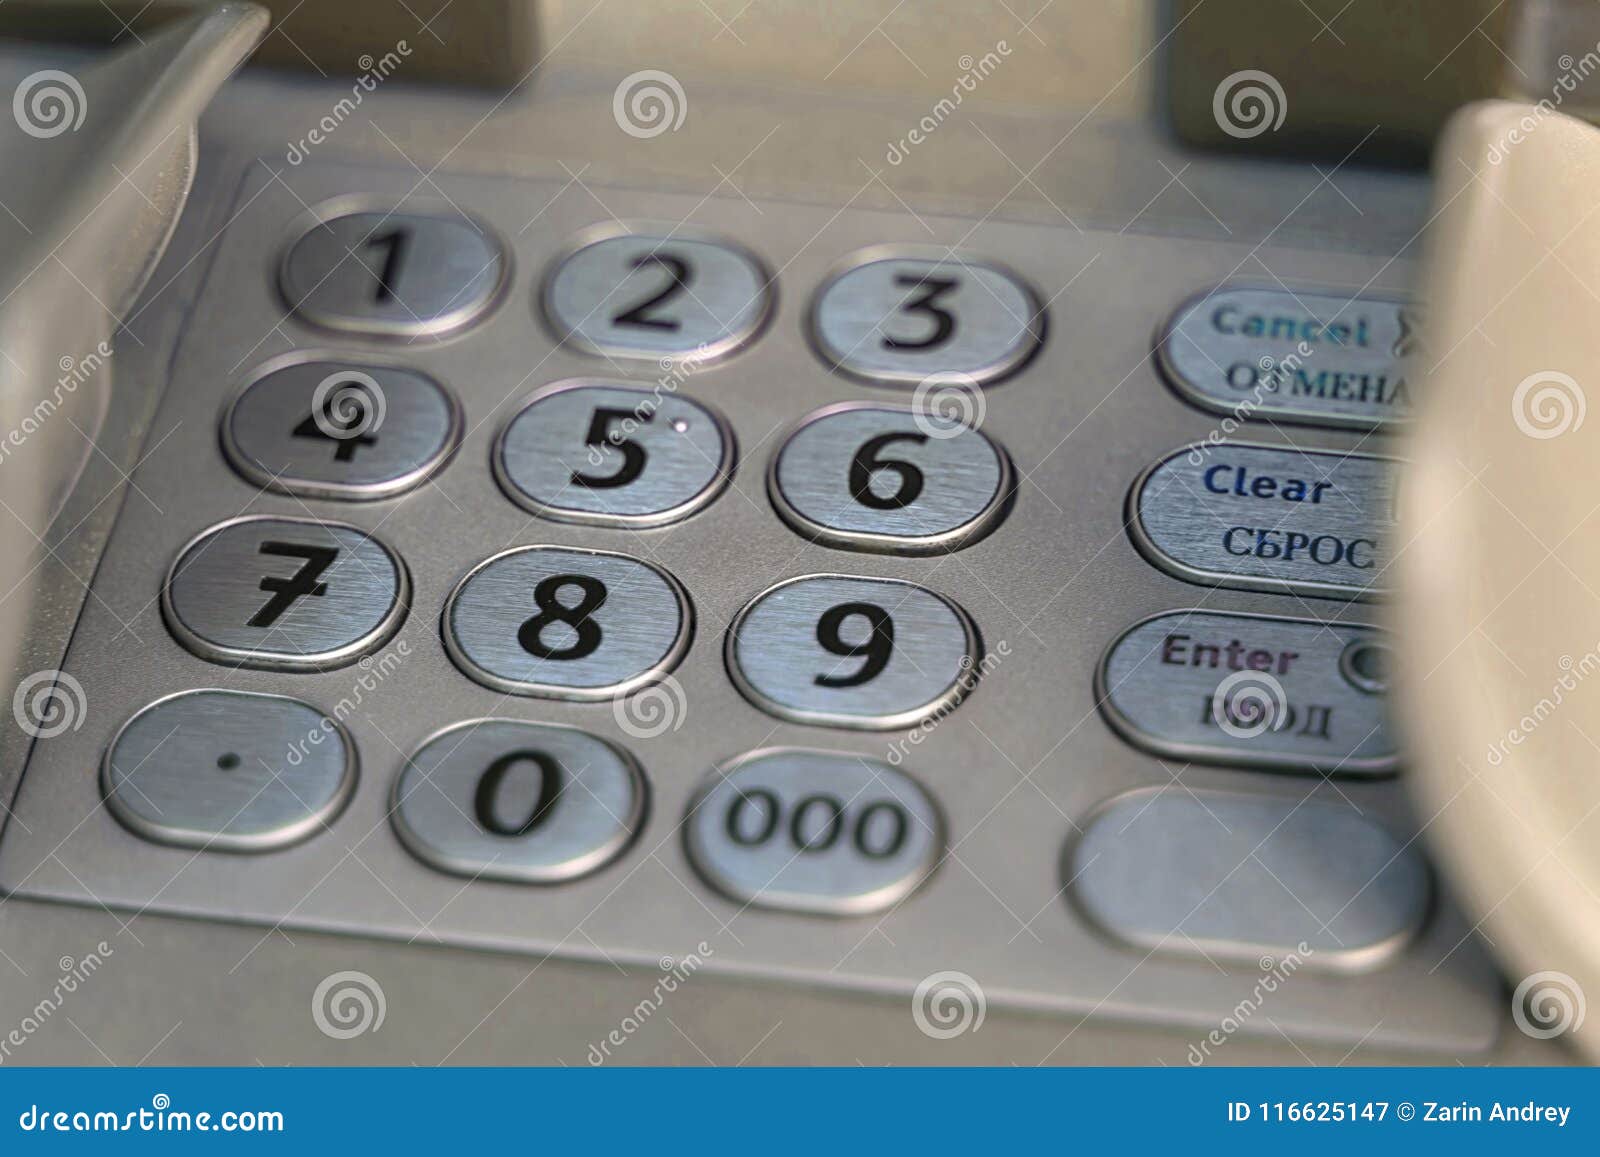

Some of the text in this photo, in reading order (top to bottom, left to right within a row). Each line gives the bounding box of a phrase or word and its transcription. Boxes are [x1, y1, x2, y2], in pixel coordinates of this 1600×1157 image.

[364, 229, 412, 304] 1
[612, 253, 694, 332] 2
[881, 275, 960, 352] 3
[1212, 303, 1369, 348] Cancel
[291, 381, 378, 462] 4
[570, 406, 656, 490] 5
[848, 431, 931, 511] 6
[1203, 464, 1333, 504] Clear
[246, 540, 340, 628] 7
[1222, 526, 1378, 569] СБРОС
[516, 573, 608, 662] 8
[813, 601, 895, 689] 9
[1160, 634, 1299, 675] Enter
[473, 748, 564, 838] 0
[725, 789, 908, 860] 000
